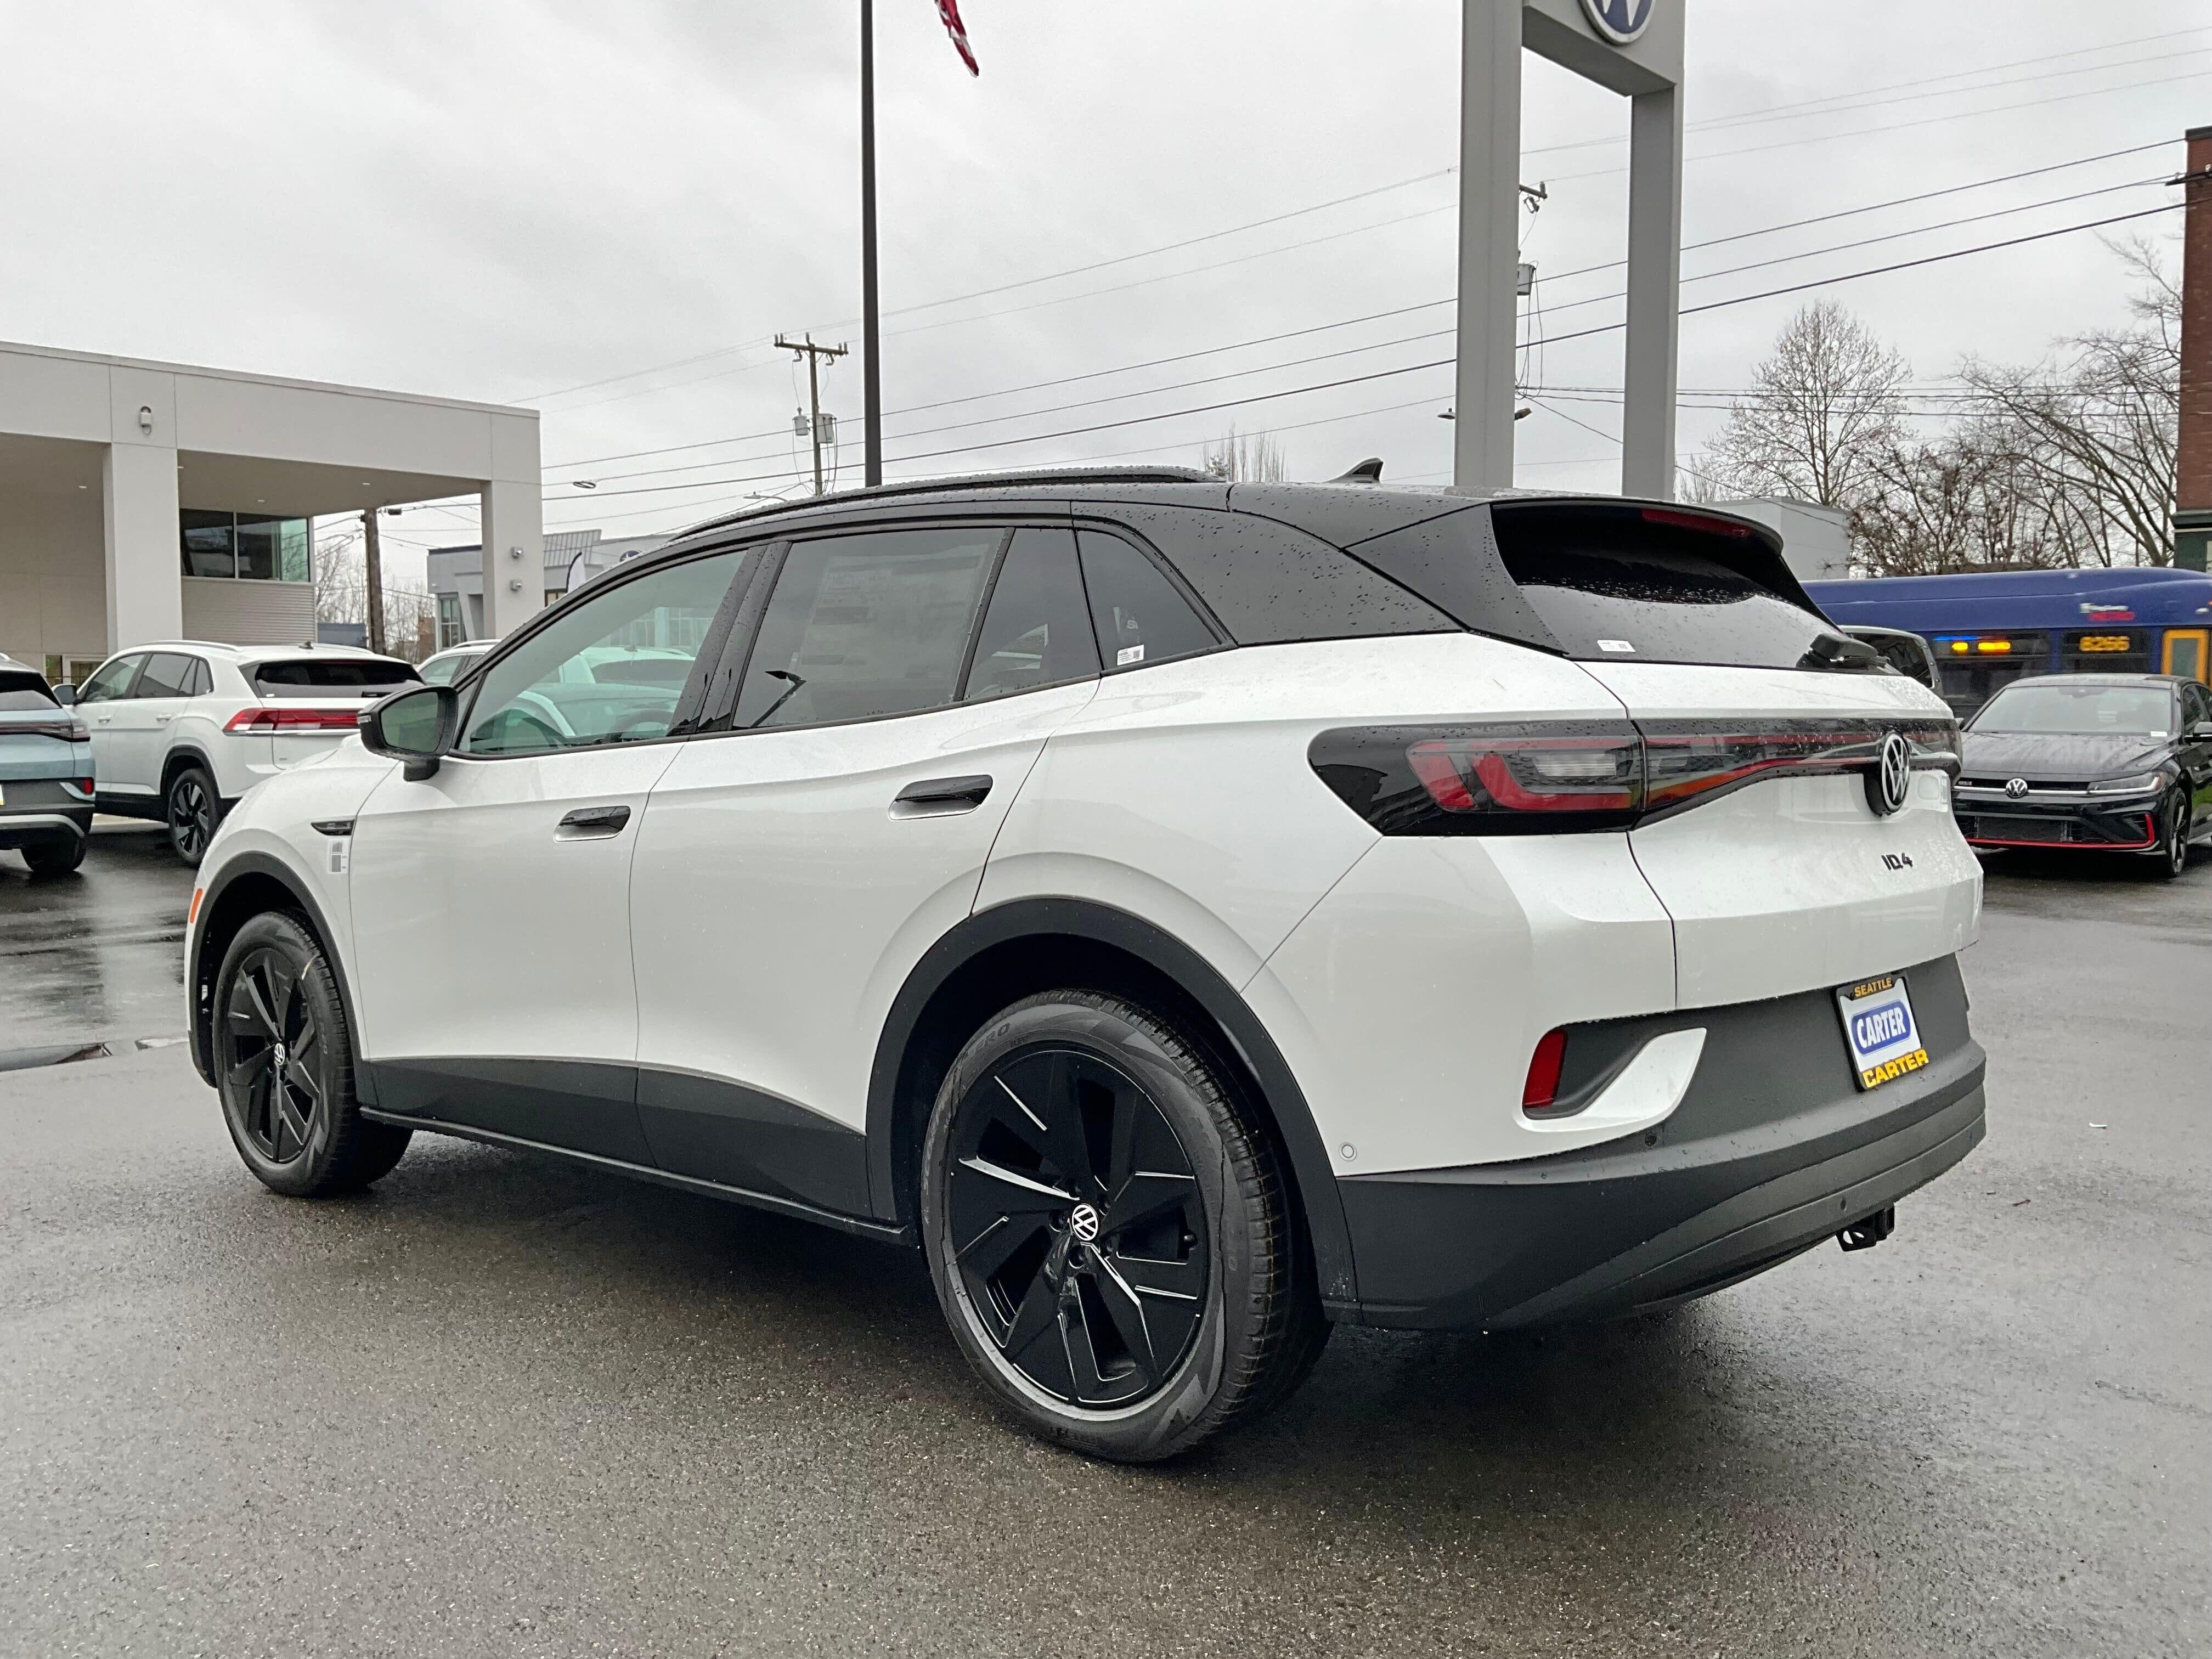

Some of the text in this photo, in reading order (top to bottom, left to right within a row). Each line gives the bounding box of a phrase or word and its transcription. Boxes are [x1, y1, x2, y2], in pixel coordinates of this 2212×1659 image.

[1854, 977, 1892, 997] SEATTLE
[1857, 1007, 1906, 1048] CARTER
[1862, 1049, 1929, 1088] CARTER
